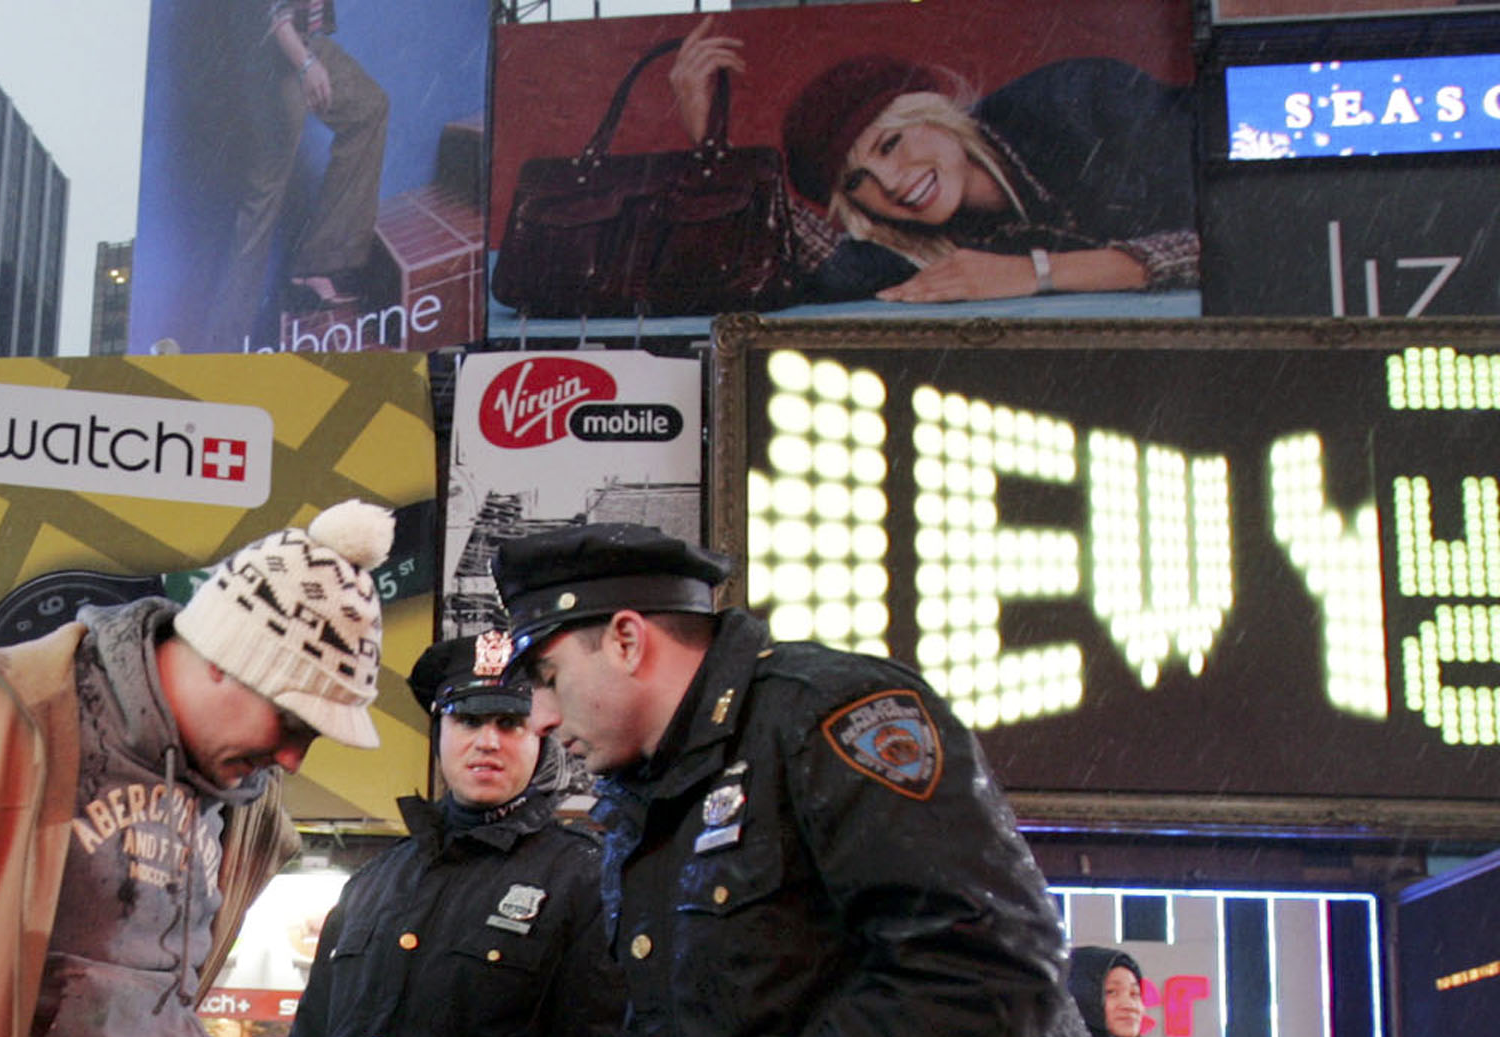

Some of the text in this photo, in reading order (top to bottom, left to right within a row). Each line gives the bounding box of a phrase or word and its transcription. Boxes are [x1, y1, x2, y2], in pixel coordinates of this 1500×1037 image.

[243, 295, 442, 353] borne
[493, 361, 590, 440] Virgin
[583, 409, 669, 434] mobile
